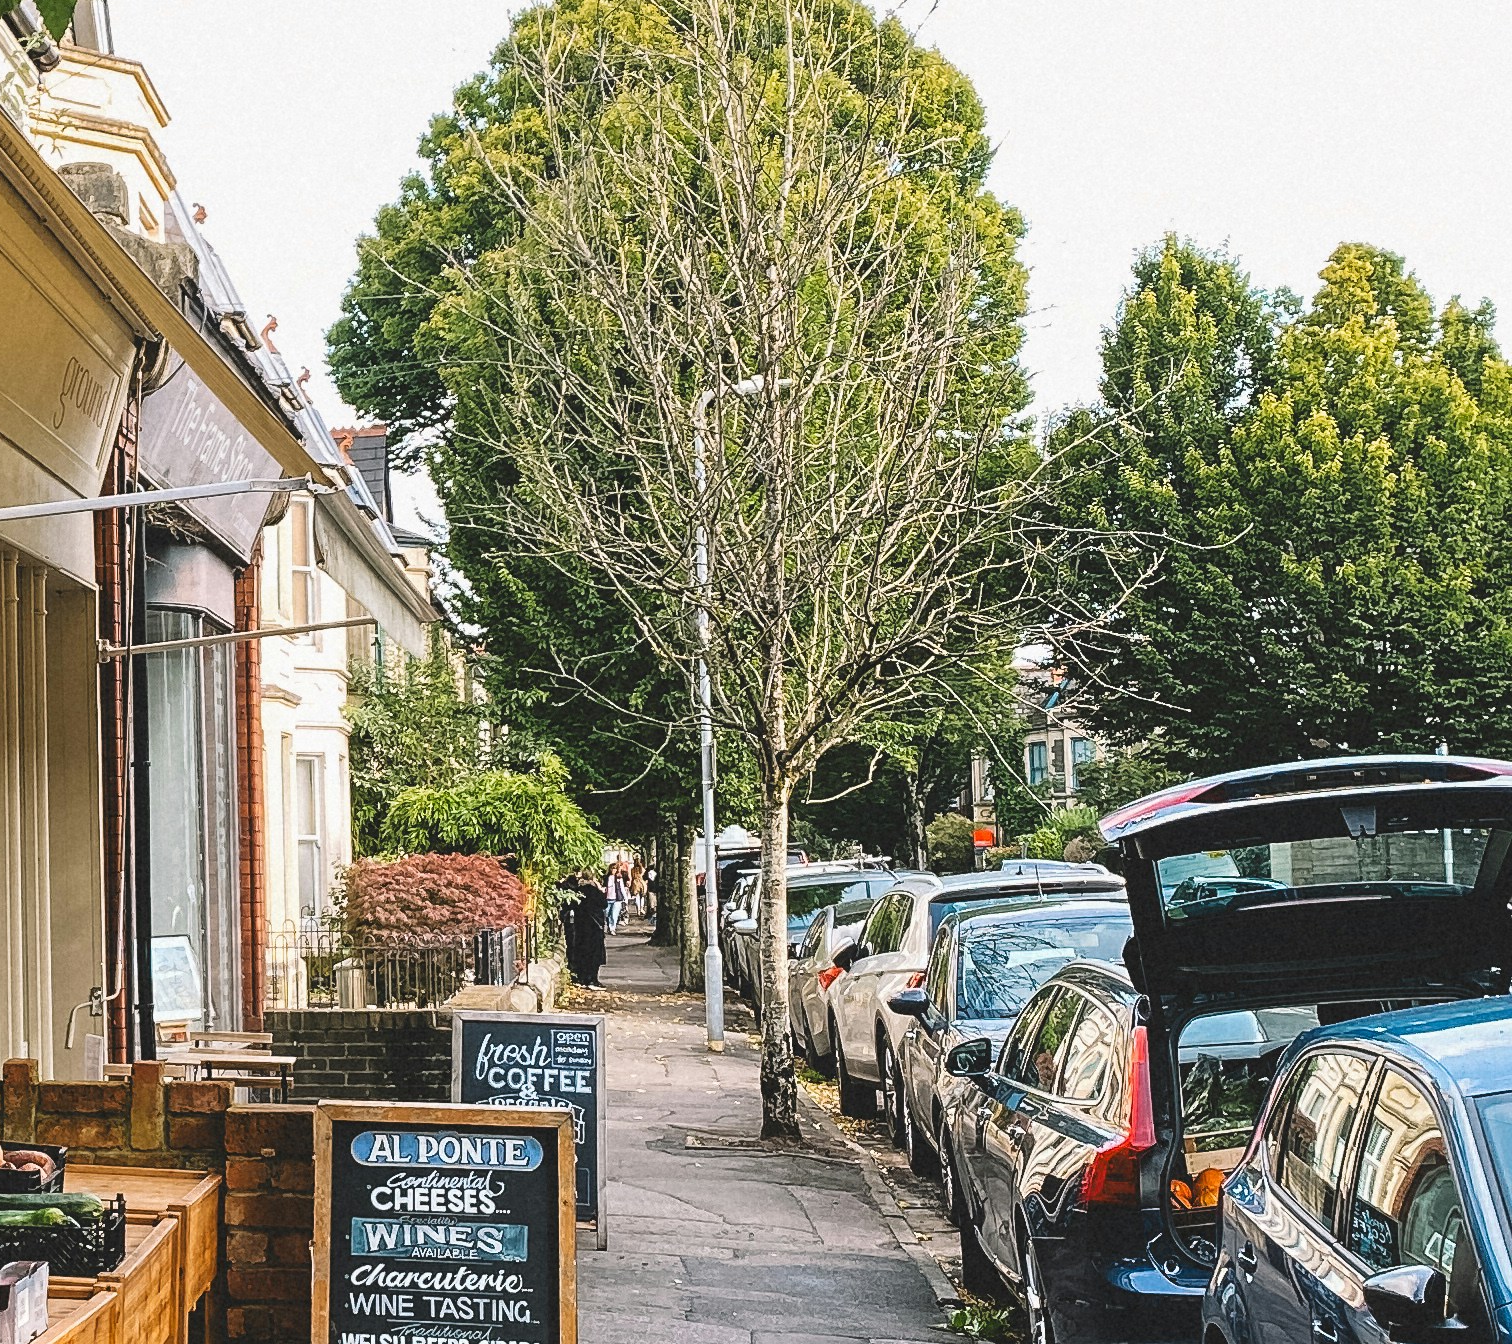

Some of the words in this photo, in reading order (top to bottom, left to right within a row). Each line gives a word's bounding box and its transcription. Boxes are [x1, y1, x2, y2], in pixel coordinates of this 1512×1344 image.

[52, 356, 115, 430] ground
[171, 378, 201, 446] The
[191, 402, 231, 475] Frame
[557, 1033, 590, 1044] open
[475, 1033, 552, 1080] fresh
[488, 1067, 592, 1094] COFFEE
[367, 1134, 411, 1163] AL
[416, 1135, 530, 1166] PONTE
[386, 1170, 505, 1197] Continental
[364, 1222, 504, 1255] WINES
[411, 1247, 480, 1260] AVAILABLE
[349, 1293, 415, 1317] WINE
[390, 1323, 493, 1342] Traditional
